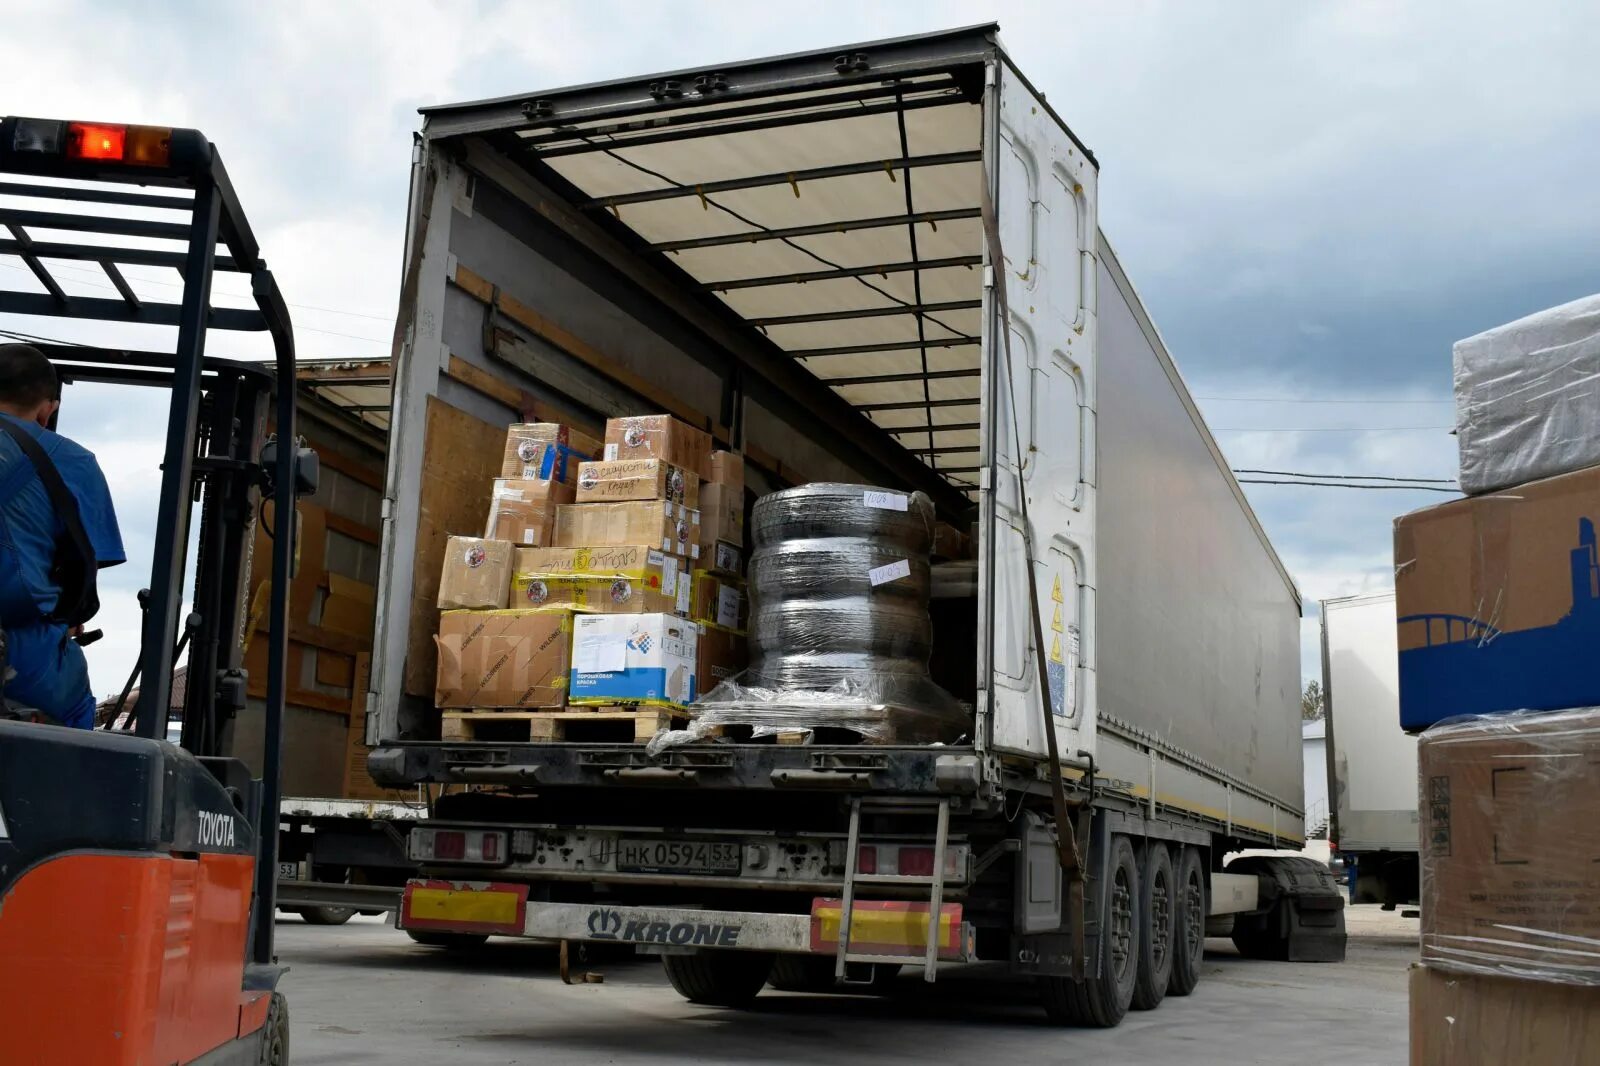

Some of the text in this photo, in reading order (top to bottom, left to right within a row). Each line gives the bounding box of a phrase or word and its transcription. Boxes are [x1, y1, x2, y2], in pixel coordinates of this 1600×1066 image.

[480, 654, 509, 688] WILDBERRIES
[198, 810, 235, 847] TOYOTA
[654, 843, 707, 867] 0594
[712, 844, 733, 861] 53
[280, 864, 292, 875] 53
[623, 921, 742, 946] KRONE
